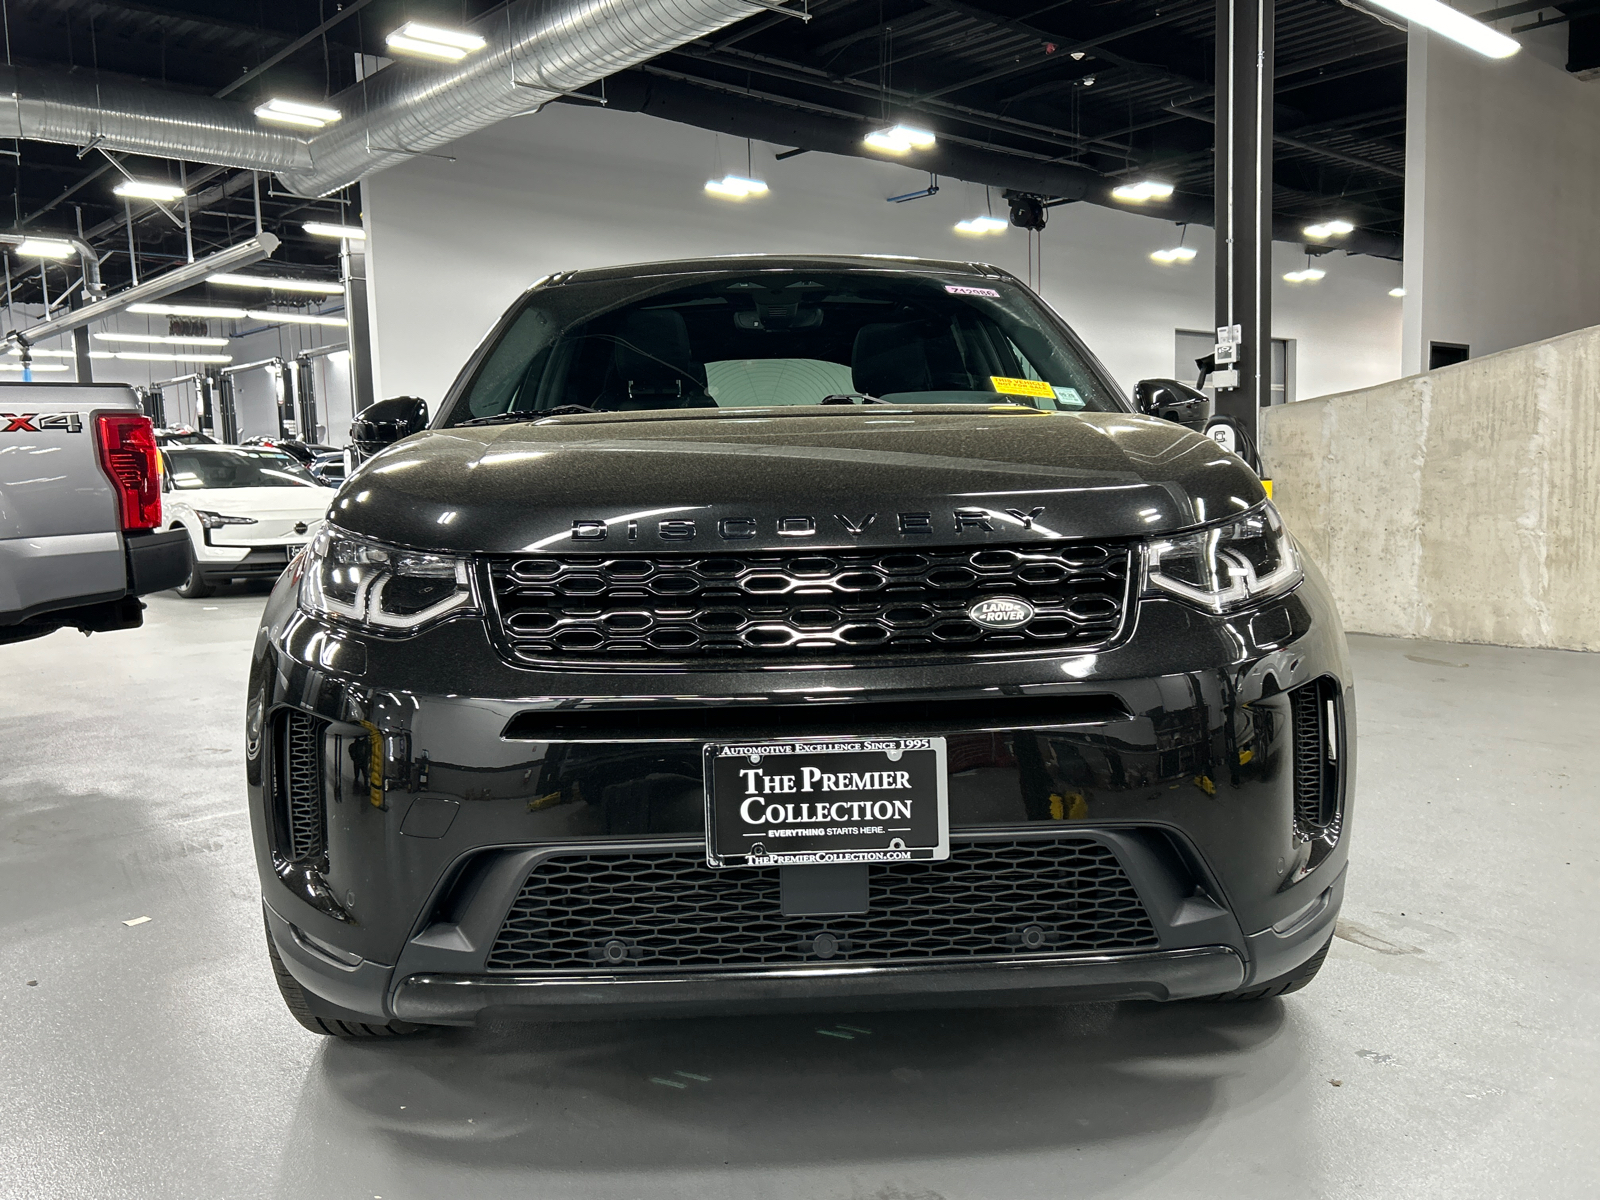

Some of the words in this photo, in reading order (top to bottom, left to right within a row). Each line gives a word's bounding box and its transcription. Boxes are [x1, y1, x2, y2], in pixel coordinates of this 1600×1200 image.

[1013, 379, 1047, 387] VEHICLE
[571, 506, 1045, 541] DISCOVERY
[982, 602, 1014, 613] LAND
[986, 611, 1024, 621] ROVER
[721, 745, 792, 755] AUTOMOTIVE
[795, 742, 862, 753] EXCELLENCE
[863, 741, 897, 751] SINCE
[900, 739, 929, 749] 1995
[739, 768, 797, 795] THE
[800, 766, 912, 792] PREMIER
[740, 796, 913, 825] COLLECTION
[768, 827, 825, 838] EVERYTHING
[826, 827, 859, 836] STARTS
[860, 826, 885, 834] HERE.
[745, 851, 911, 865] THEPREMIERCOLLECTION.COM
